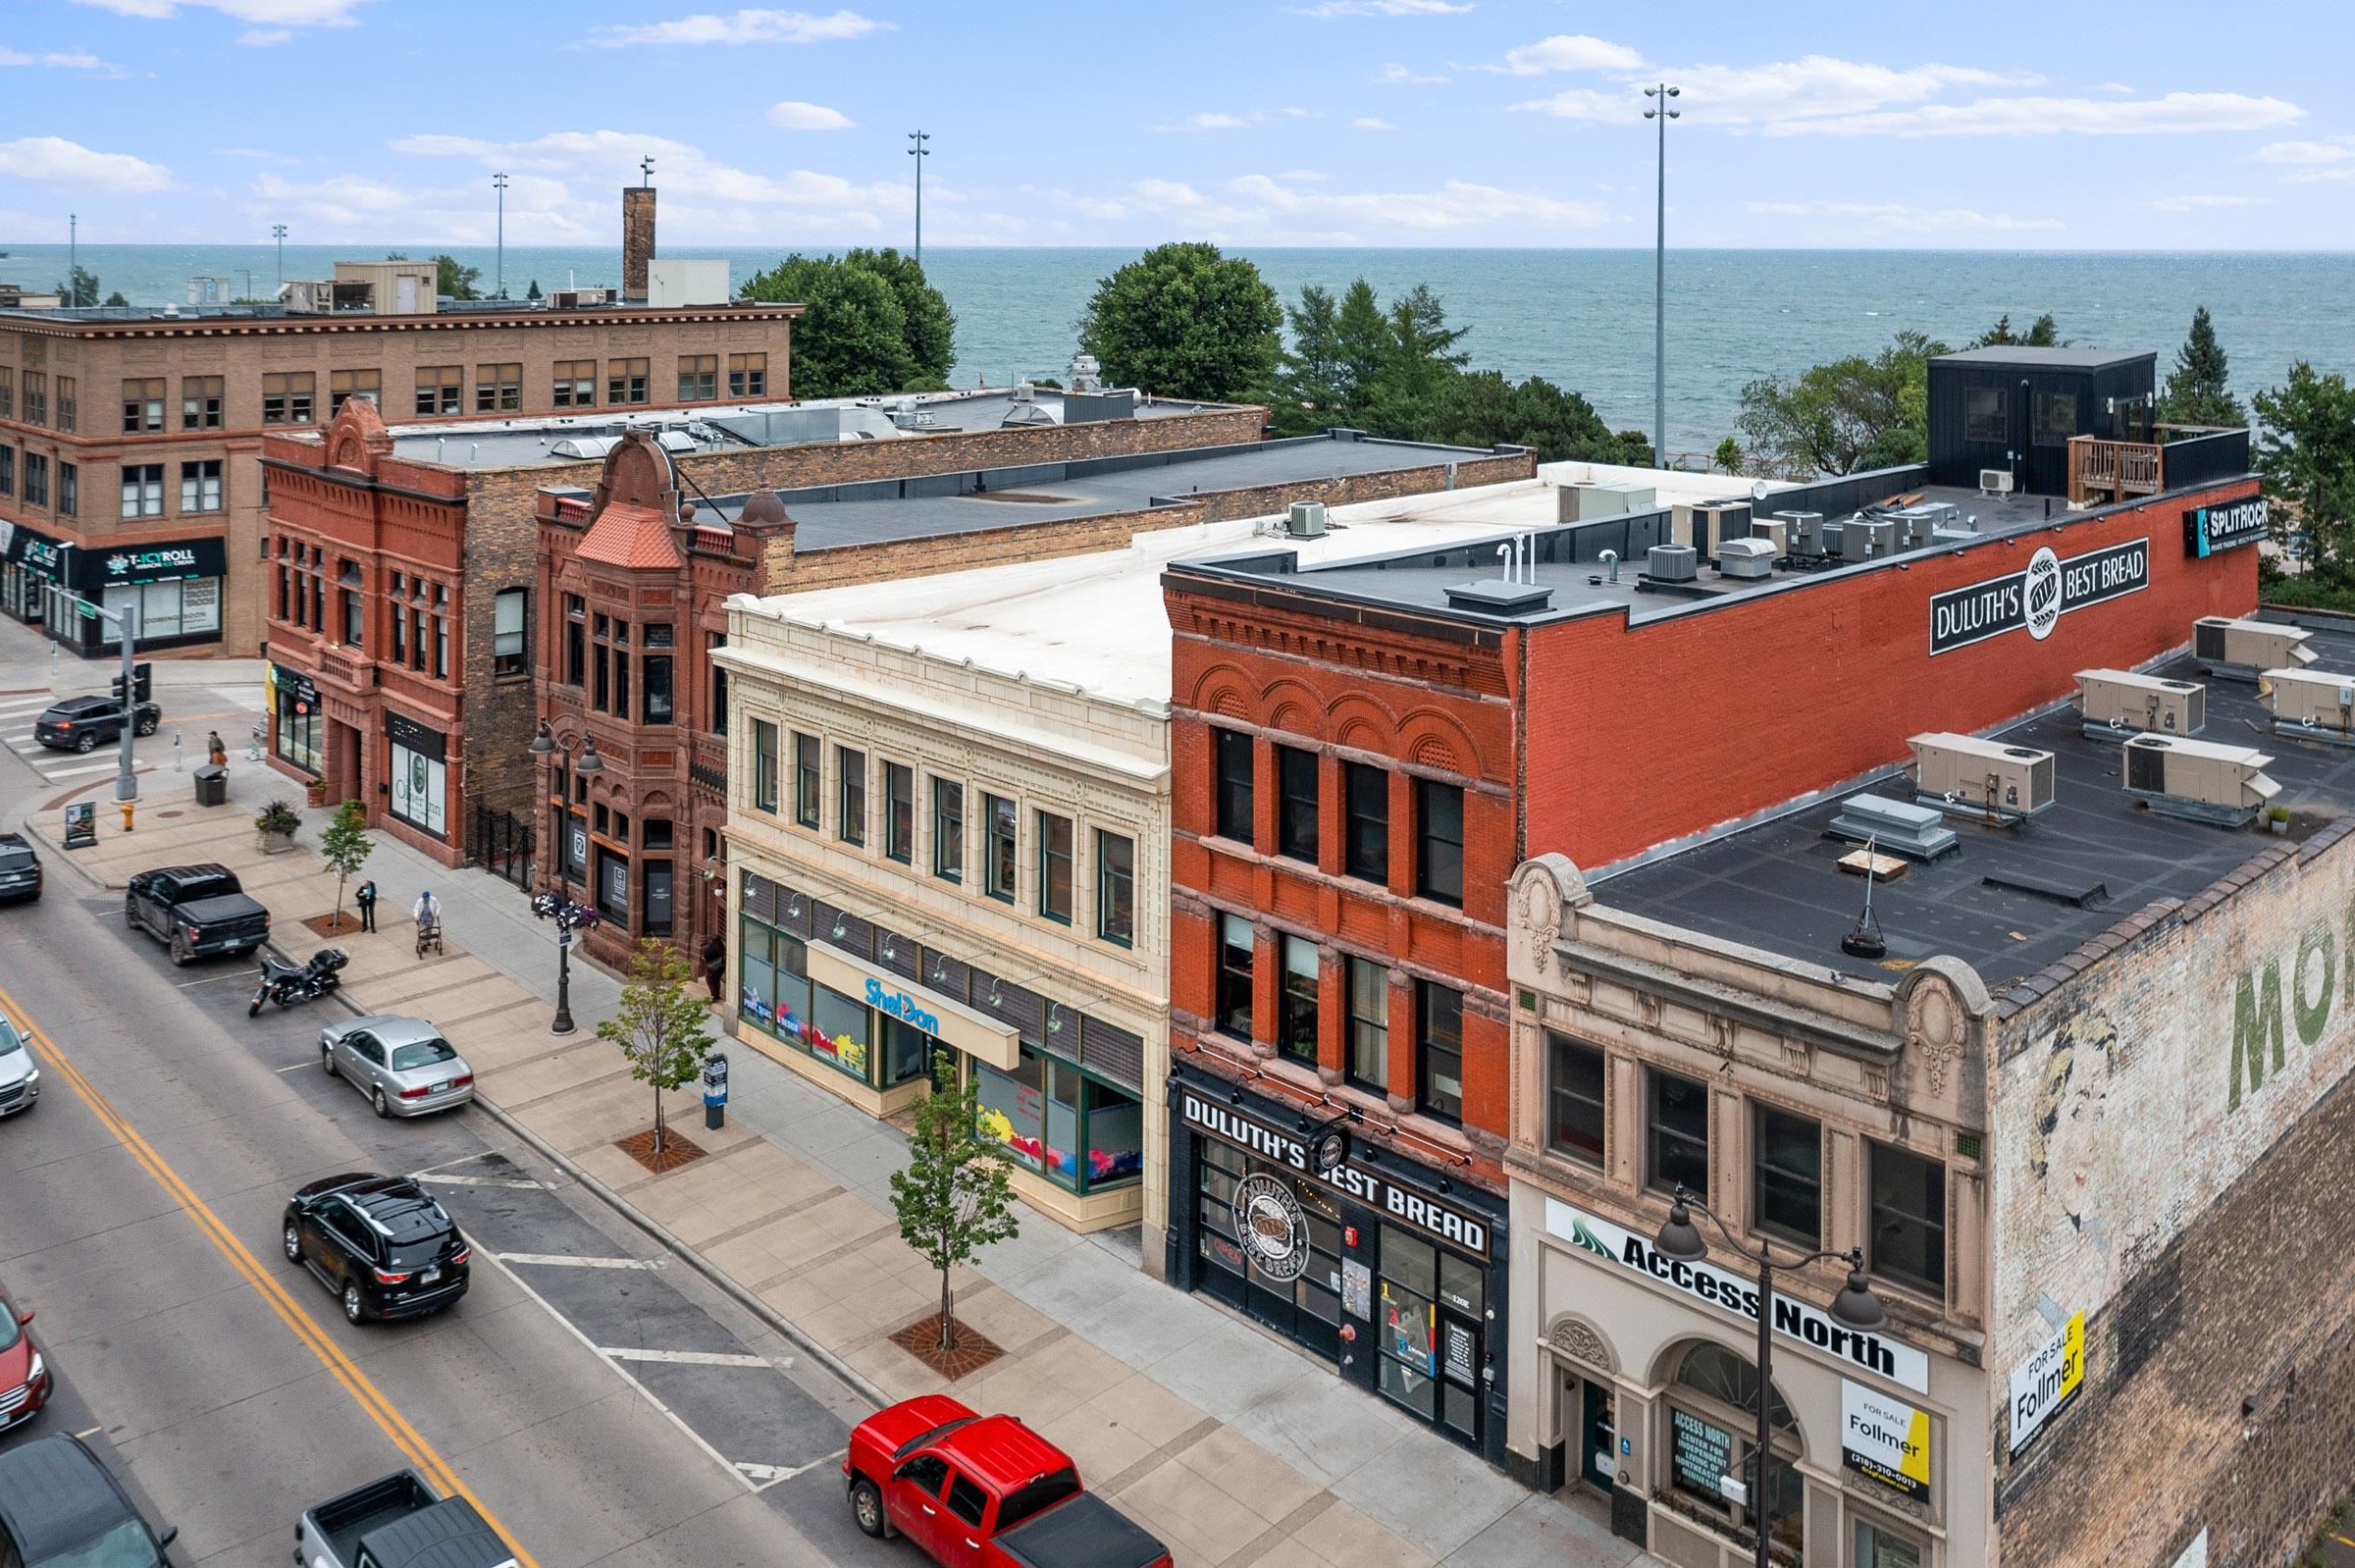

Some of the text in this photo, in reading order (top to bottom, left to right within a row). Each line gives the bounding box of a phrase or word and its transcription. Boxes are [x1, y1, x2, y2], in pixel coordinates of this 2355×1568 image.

[2211, 500, 2269, 538] SPLITROCK
[129, 549, 195, 566] T-ICYROLL
[1937, 550, 2144, 640] DULUTH'S BEST BREAD
[864, 978, 939, 1036] ShelDon
[1185, 1095, 1306, 1171] DULUTH'S
[1318, 1164, 1379, 1202] EST
[1387, 1184, 1485, 1252] BREAD
[1389, 1307, 1398, 1325] 2
[1623, 1236, 1895, 1378] Access North
[2028, 1325, 2073, 1381] FOR SALE
[2016, 1349, 2078, 1430] Follmer
[1674, 1411, 1731, 1450] ACCESS NORTH
[1863, 1403, 1907, 1429] FOR SALE
[1678, 1438, 1728, 1469] INDEPENDENT
[1681, 1432, 1725, 1459] CENTER FOR
[1850, 1414, 1920, 1458] Follmer
[1674, 1454, 1721, 1484] NORTHEASTE
[1685, 1451, 1720, 1474] LIVING OF
[1852, 1453, 1917, 1489] (218)-310-0013
